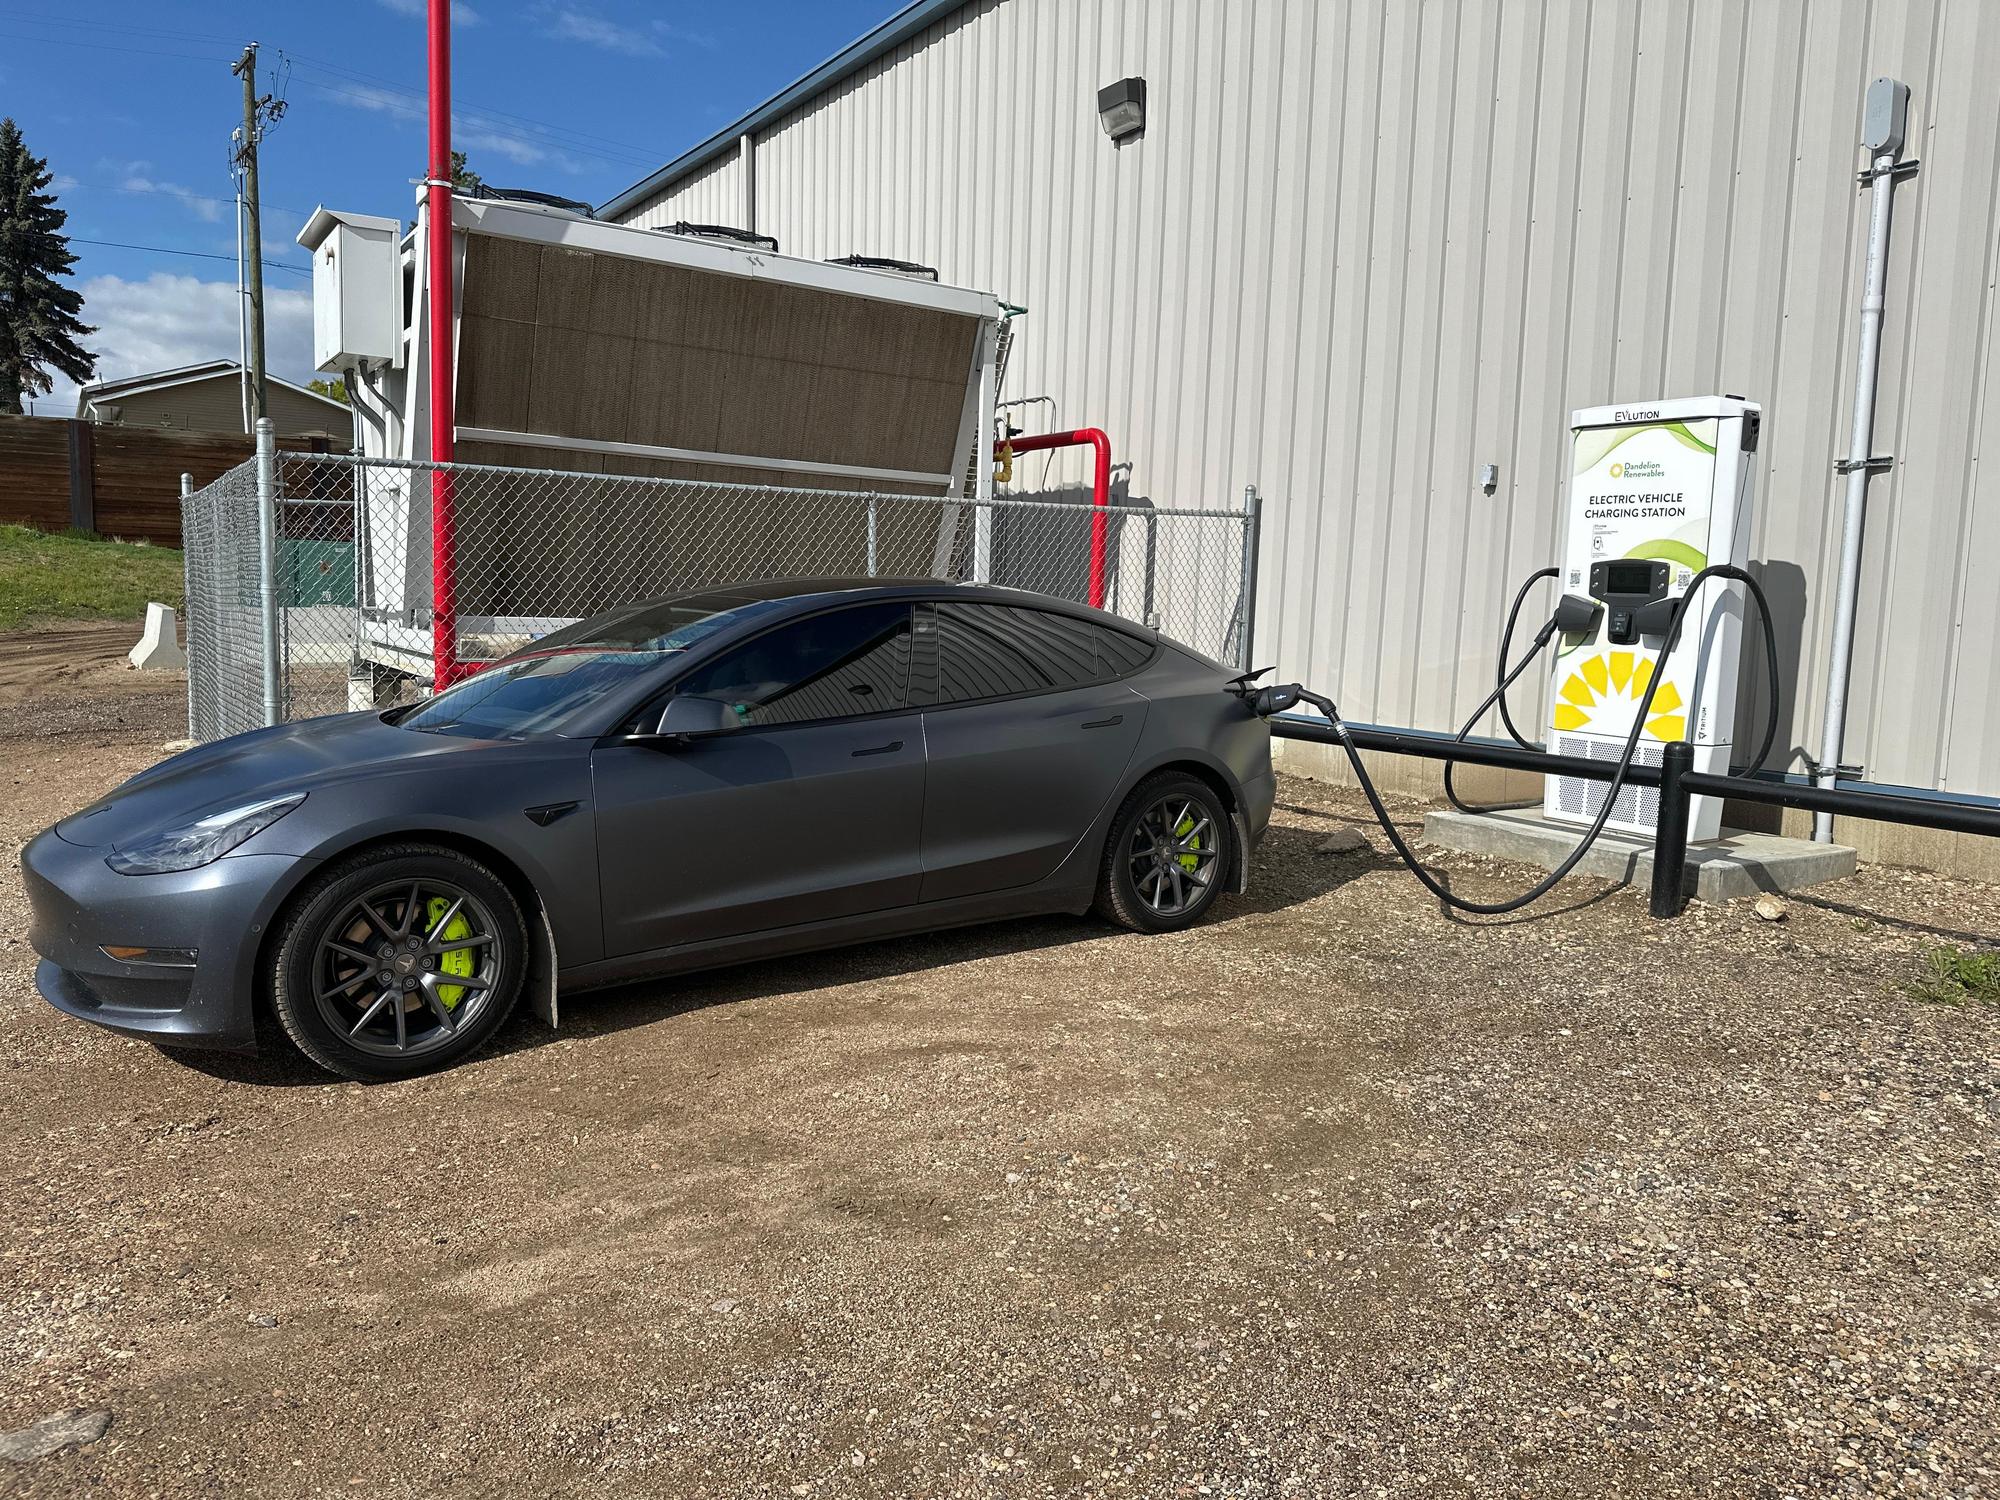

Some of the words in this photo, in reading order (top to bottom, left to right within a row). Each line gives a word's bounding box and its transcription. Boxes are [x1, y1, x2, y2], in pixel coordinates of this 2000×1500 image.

[1624, 461, 1661, 470] Dandelion
[1623, 469, 1665, 478] Renewables
[1589, 494, 1636, 505] ELECTRIC
[1638, 493, 1683, 503] VEHICLE
[1584, 508, 1639, 519] CHARGING
[1641, 507, 1686, 517] STATION
